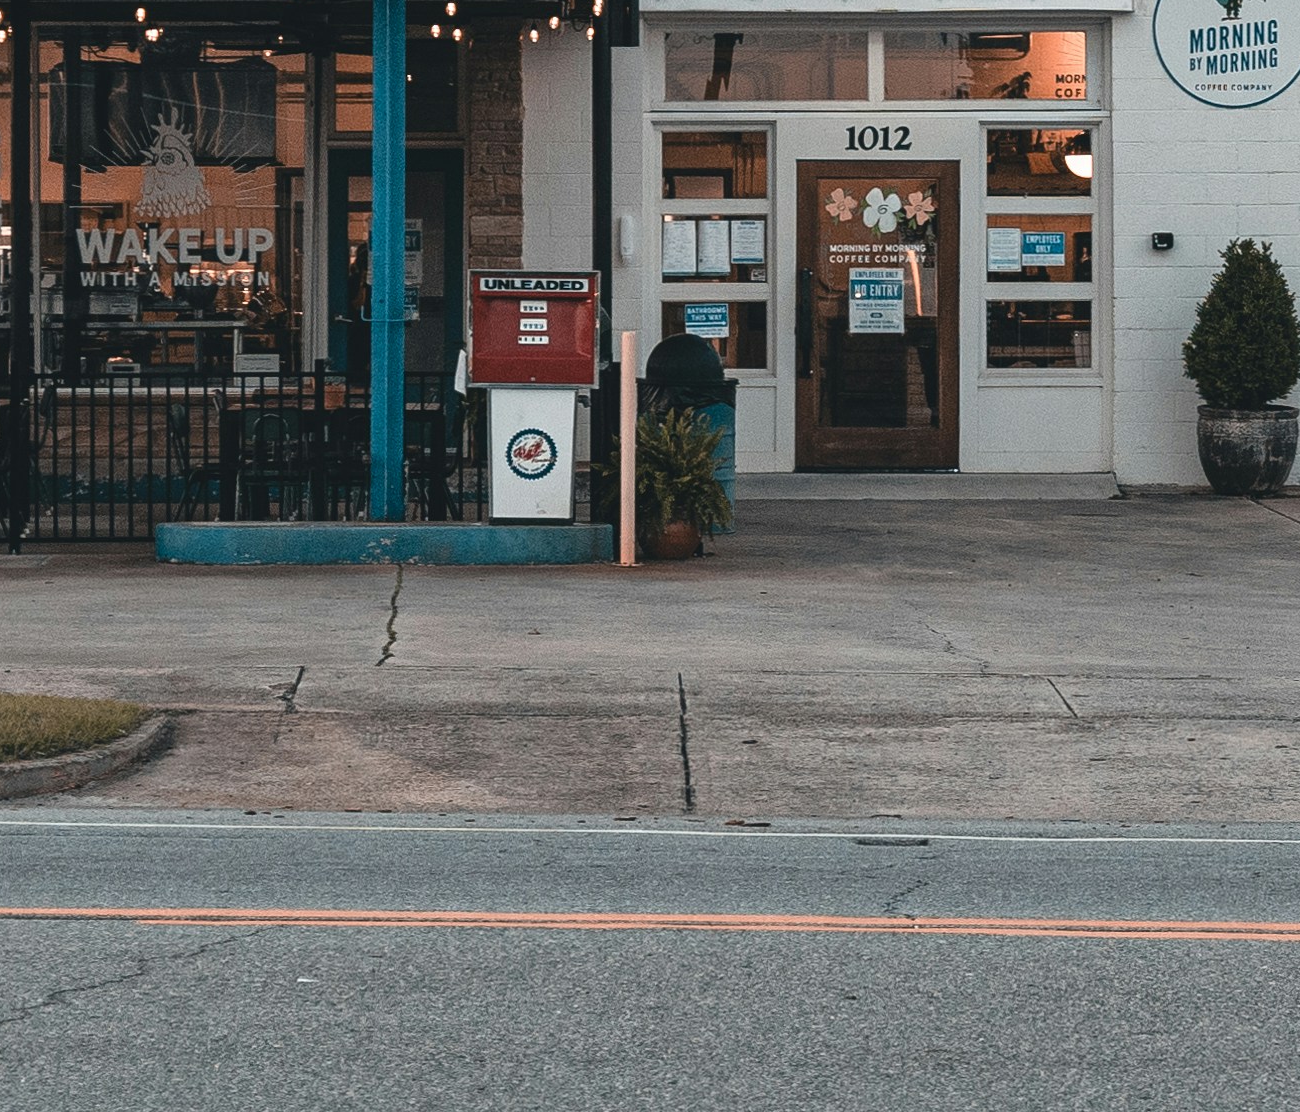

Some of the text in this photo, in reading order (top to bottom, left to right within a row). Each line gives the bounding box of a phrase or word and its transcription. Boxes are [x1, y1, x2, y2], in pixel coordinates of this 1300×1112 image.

[1189, 19, 1278, 54] MORNING
[1189, 47, 1278, 76] BY MORNING
[1055, 88, 1086, 98] COF
[844, 125, 913, 151] 1012
[1026, 235, 1060, 244] EMPLOYEES
[75, 227, 274, 265] WAKE UP
[829, 244, 927, 252] MORNING BY MORNING
[1035, 244, 1051, 253] ONLY
[829, 255, 871, 263] COFFEE
[79, 271, 270, 287] WITH A MISSION
[484, 279, 584, 291] UNLEADED
[854, 284, 899, 297] NO ENTRY
[686, 306, 727, 314] BATHROOMS
